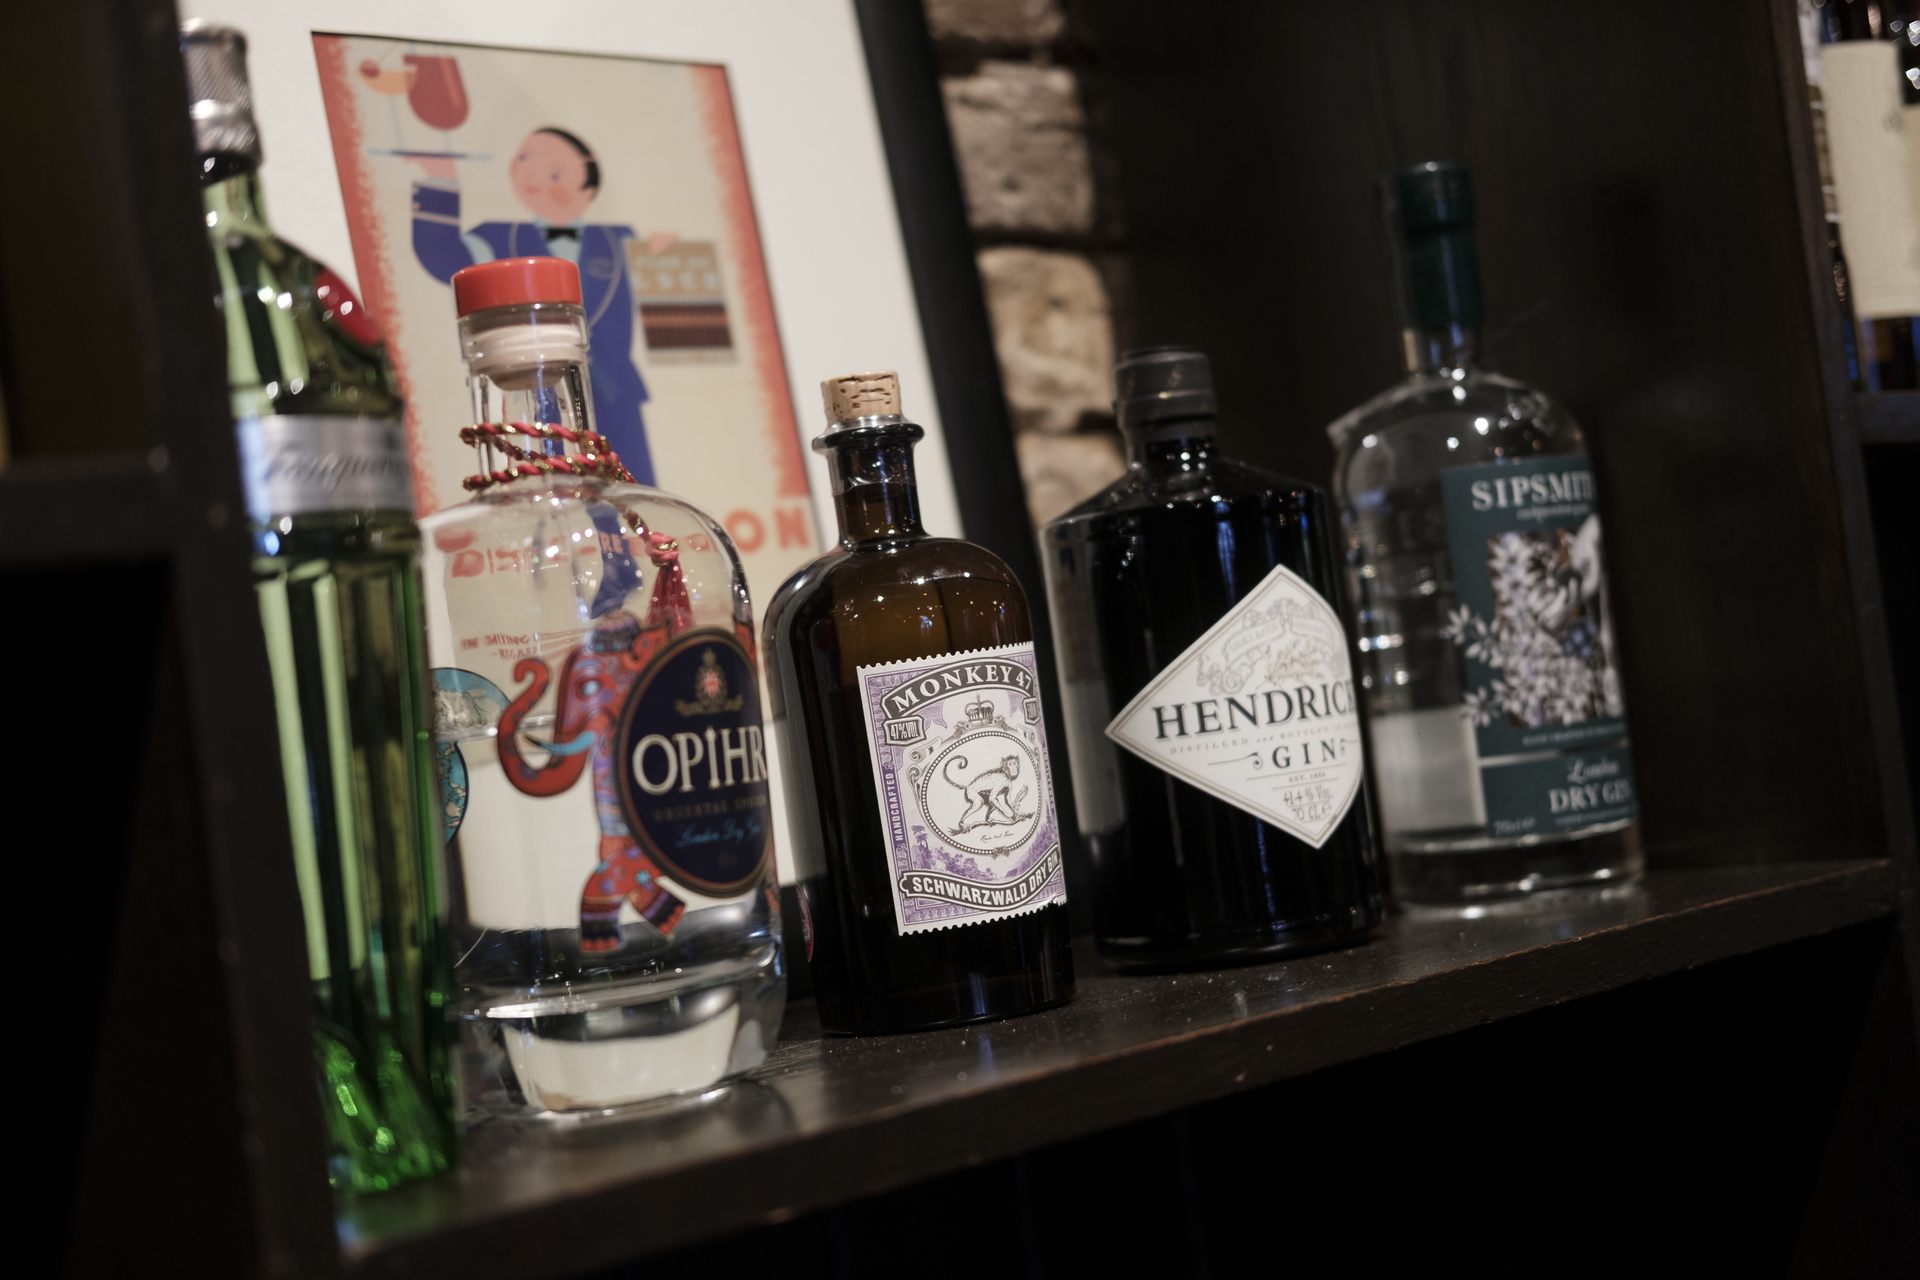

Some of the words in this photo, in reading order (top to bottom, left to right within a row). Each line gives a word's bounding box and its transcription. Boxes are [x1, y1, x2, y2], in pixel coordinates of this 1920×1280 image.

[891, 664, 1012, 713] MONKEY
[1015, 670, 1032, 691] 47
[632, 725, 767, 796] OPIHR
[1271, 738, 1337, 769] GIN
[885, 773, 904, 841] HANDCRAFTED
[1549, 782, 1600, 814] DRY
[912, 876, 1026, 906] SCHWARZWALD
[1029, 869, 1048, 892] DRY
